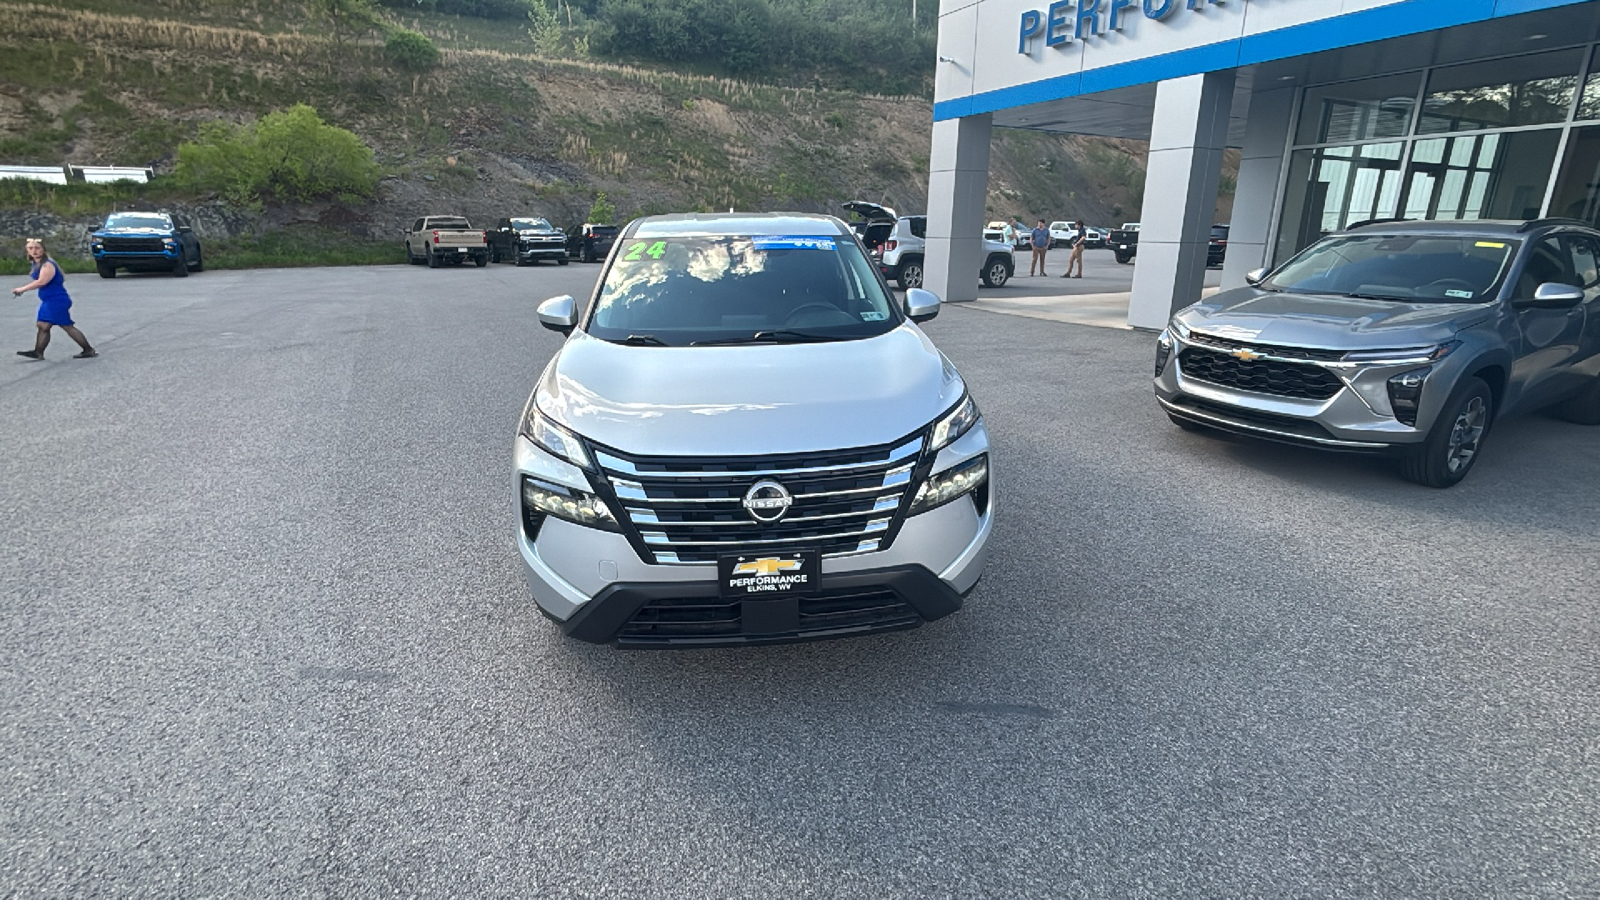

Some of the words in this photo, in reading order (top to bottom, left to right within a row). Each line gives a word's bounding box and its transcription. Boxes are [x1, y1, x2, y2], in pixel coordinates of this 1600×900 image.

[1018, 0, 1224, 54] PERF
[624, 241, 667, 261] 24
[743, 499, 792, 508] NISSAN
[729, 575, 808, 587] PERFORMANCE
[747, 584, 777, 592] ELKINS,
